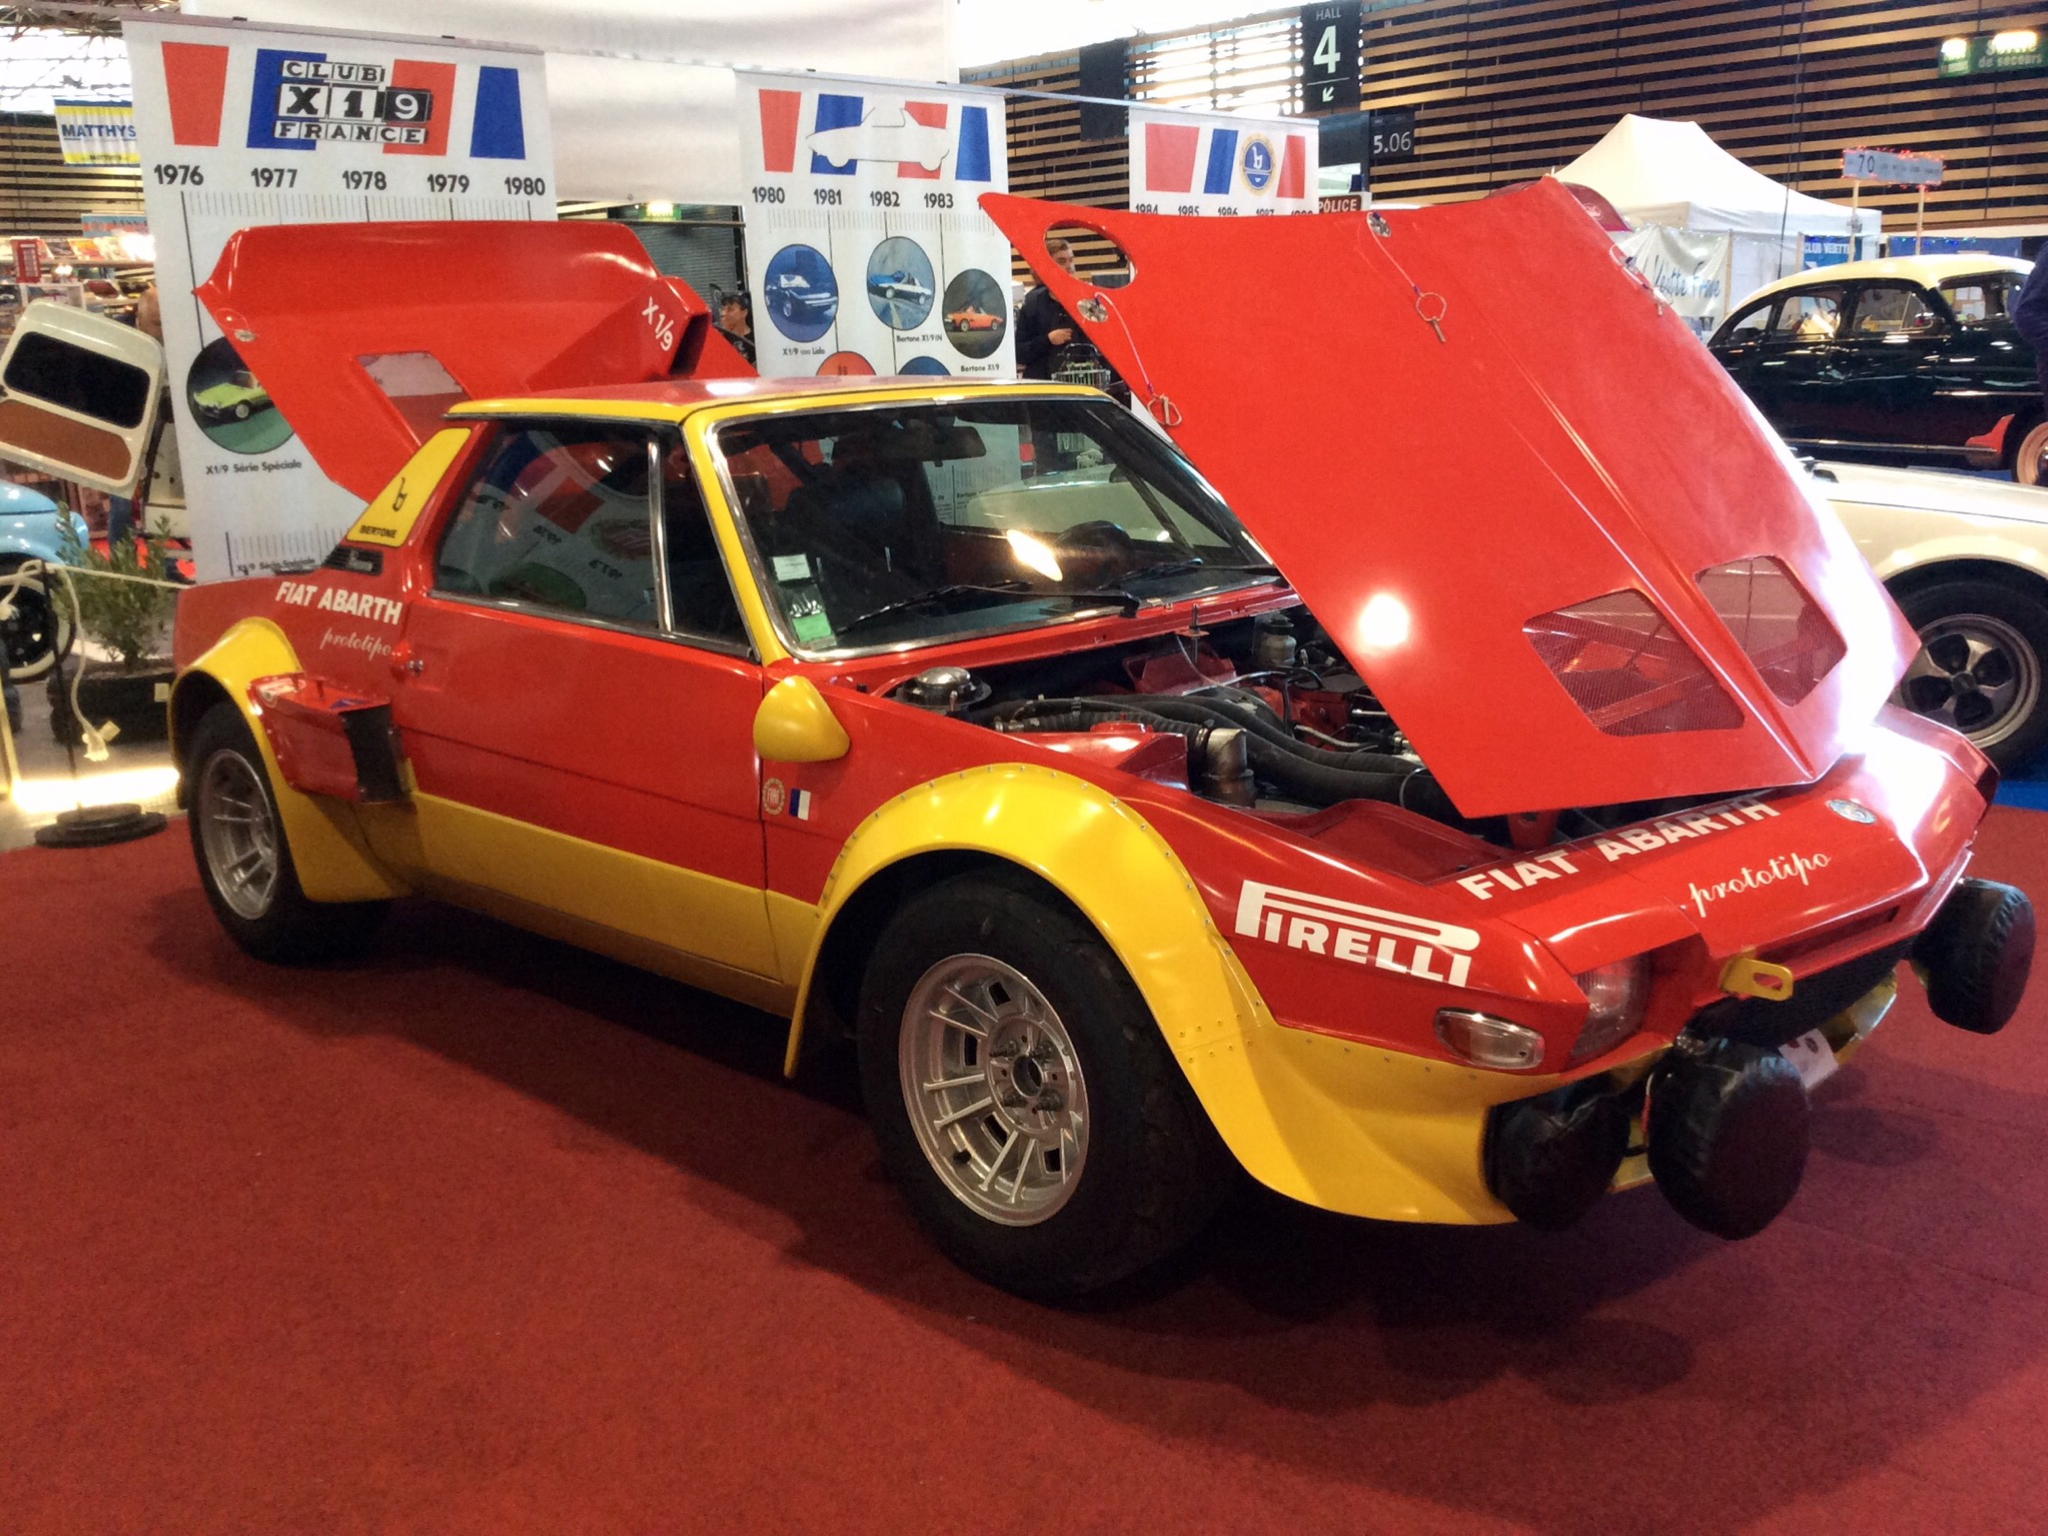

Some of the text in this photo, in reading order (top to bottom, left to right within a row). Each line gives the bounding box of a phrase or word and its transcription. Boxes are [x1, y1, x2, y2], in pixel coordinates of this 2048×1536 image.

[1315, 8, 1342, 21] HALL
[1313, 25, 1341, 74] 4
[285, 61, 381, 82] CLUB
[61, 124, 137, 138] MATTHYS
[279, 122, 423, 144] FRANCE
[1373, 131, 1412, 155] 5.06
[153, 164, 546, 196] 1976 1977 1978 1979 1980
[752, 187, 954, 209] 1980 1981 1982 1983
[1318, 198, 1358, 213] POLICE
[896, 335, 920, 343] Bertone
[960, 365, 986, 373] Bertone
[205, 464, 229, 475] X1/9
[358, 524, 398, 540] BERTONE
[275, 581, 404, 626] FIAT ABARTH
[319, 627, 392, 661] prototipo
[1456, 799, 1781, 900] FIAT ABARTH
[1688, 851, 1833, 918] prototipo
[1235, 880, 1480, 988] PIRELLI
